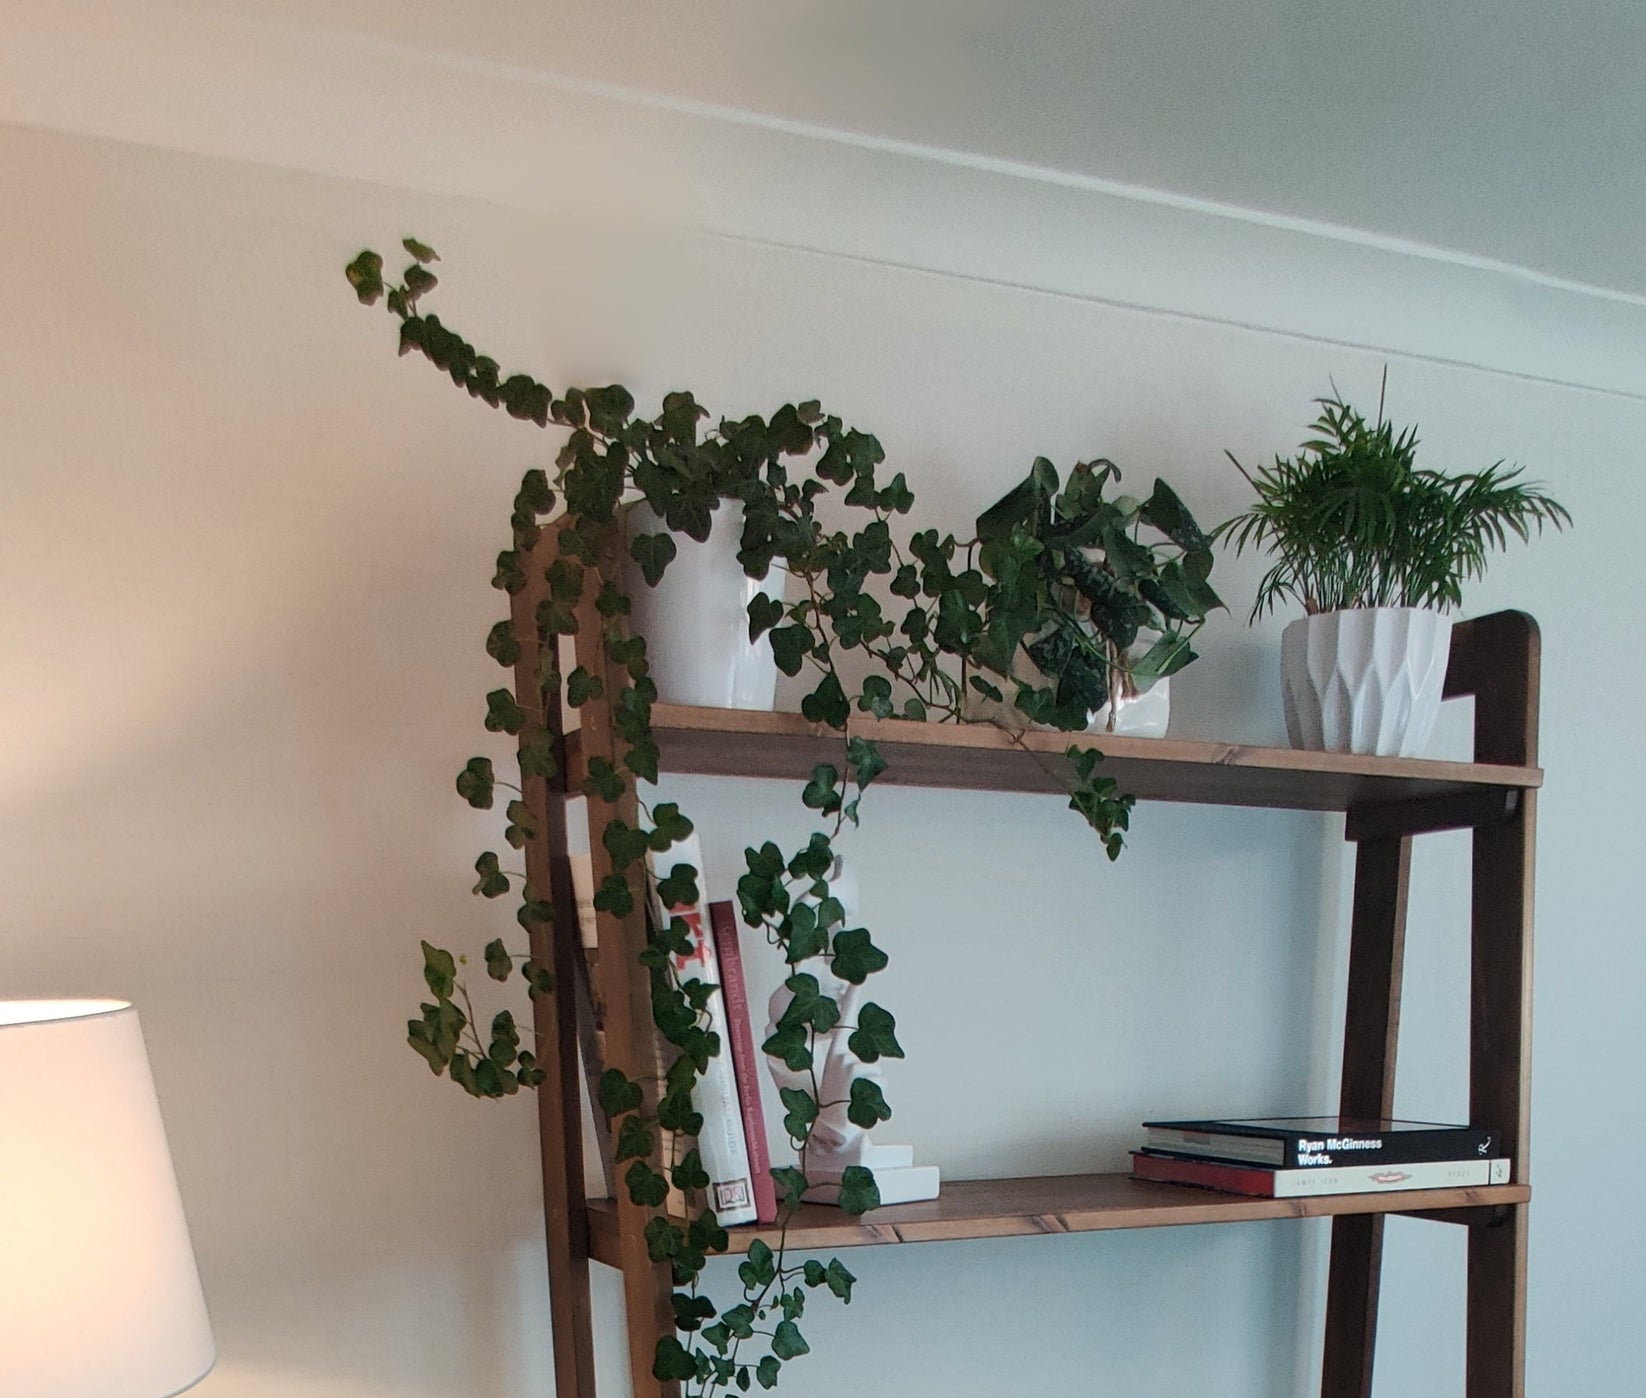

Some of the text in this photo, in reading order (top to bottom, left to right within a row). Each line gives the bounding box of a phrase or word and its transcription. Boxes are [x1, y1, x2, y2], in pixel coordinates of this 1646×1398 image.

[717, 919, 746, 1011] Rembrandt
[1298, 1138, 1382, 1153] Ryan McGinness
[1297, 1154, 1332, 1166] Works.
